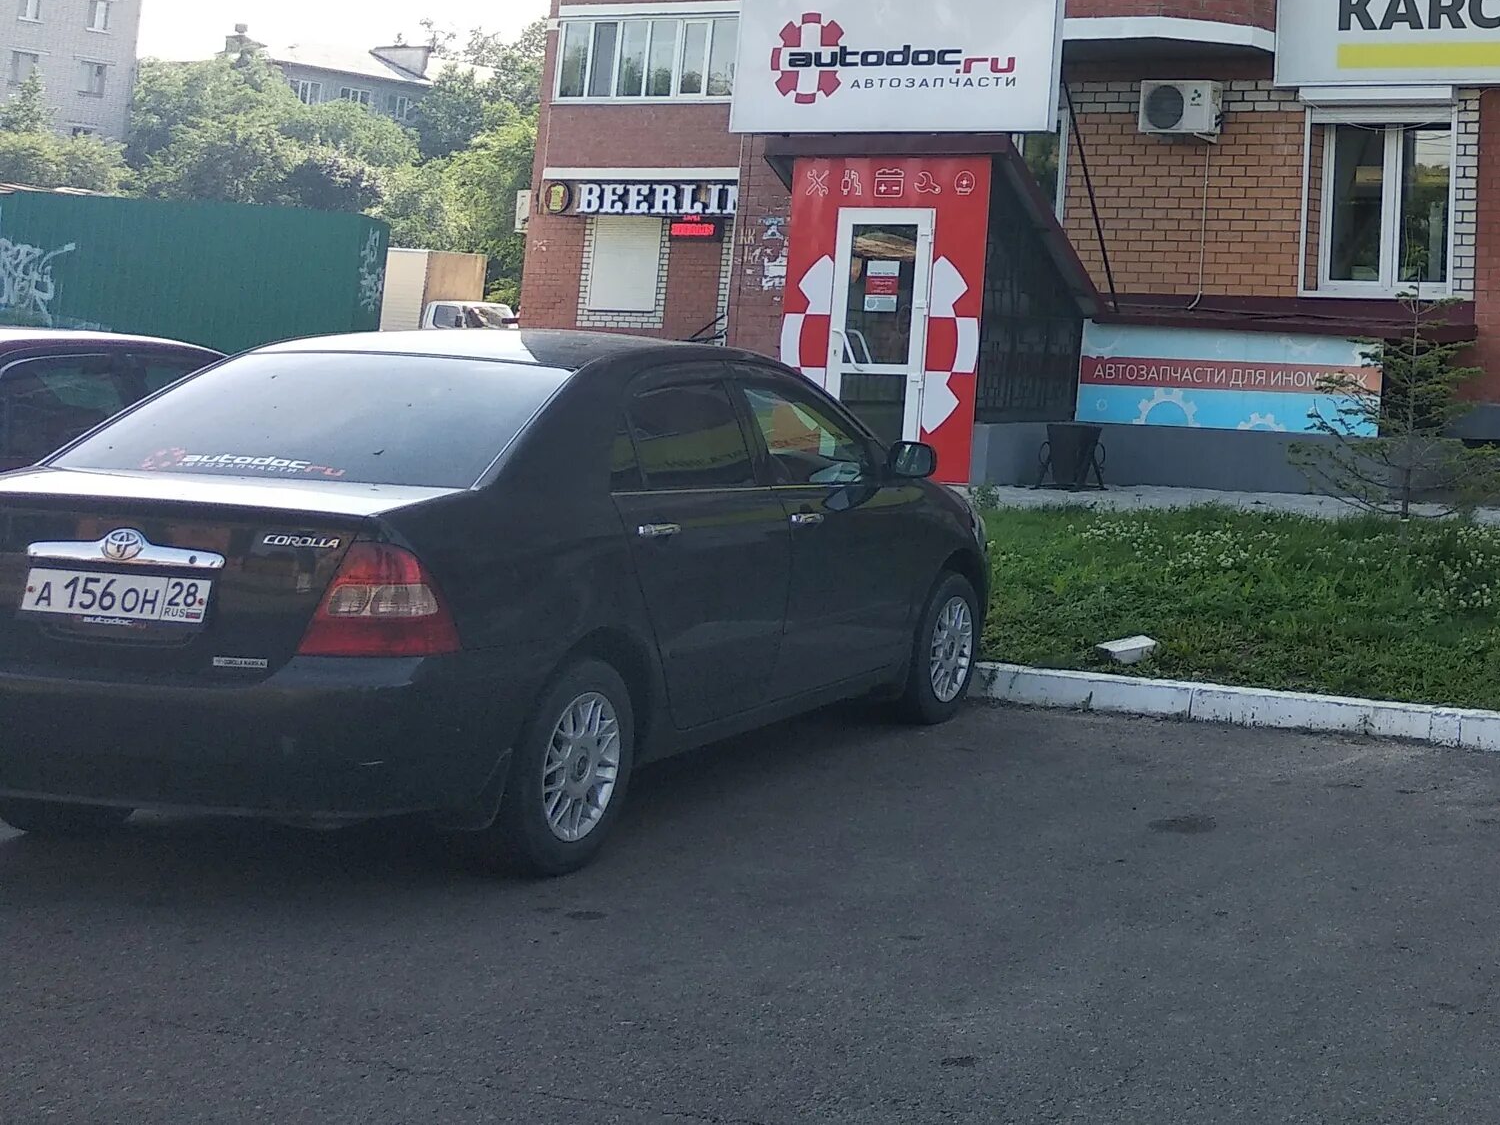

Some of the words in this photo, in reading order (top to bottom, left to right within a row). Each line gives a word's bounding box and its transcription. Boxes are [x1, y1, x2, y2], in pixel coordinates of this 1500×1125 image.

[788, 44, 1016, 74] autodoc.ru
[850, 76, 1017, 89] АВТОЗАПЧАСТИ
[1093, 363, 1226, 383] АВТОЗАПЧАСТИ
[1229, 369, 1266, 388] ДЛЯ
[1270, 370, 1368, 389] ИНОМОК
[262, 534, 342, 549] COROLLA
[167, 581, 199, 607] 28
[163, 608, 186, 618] RUS
